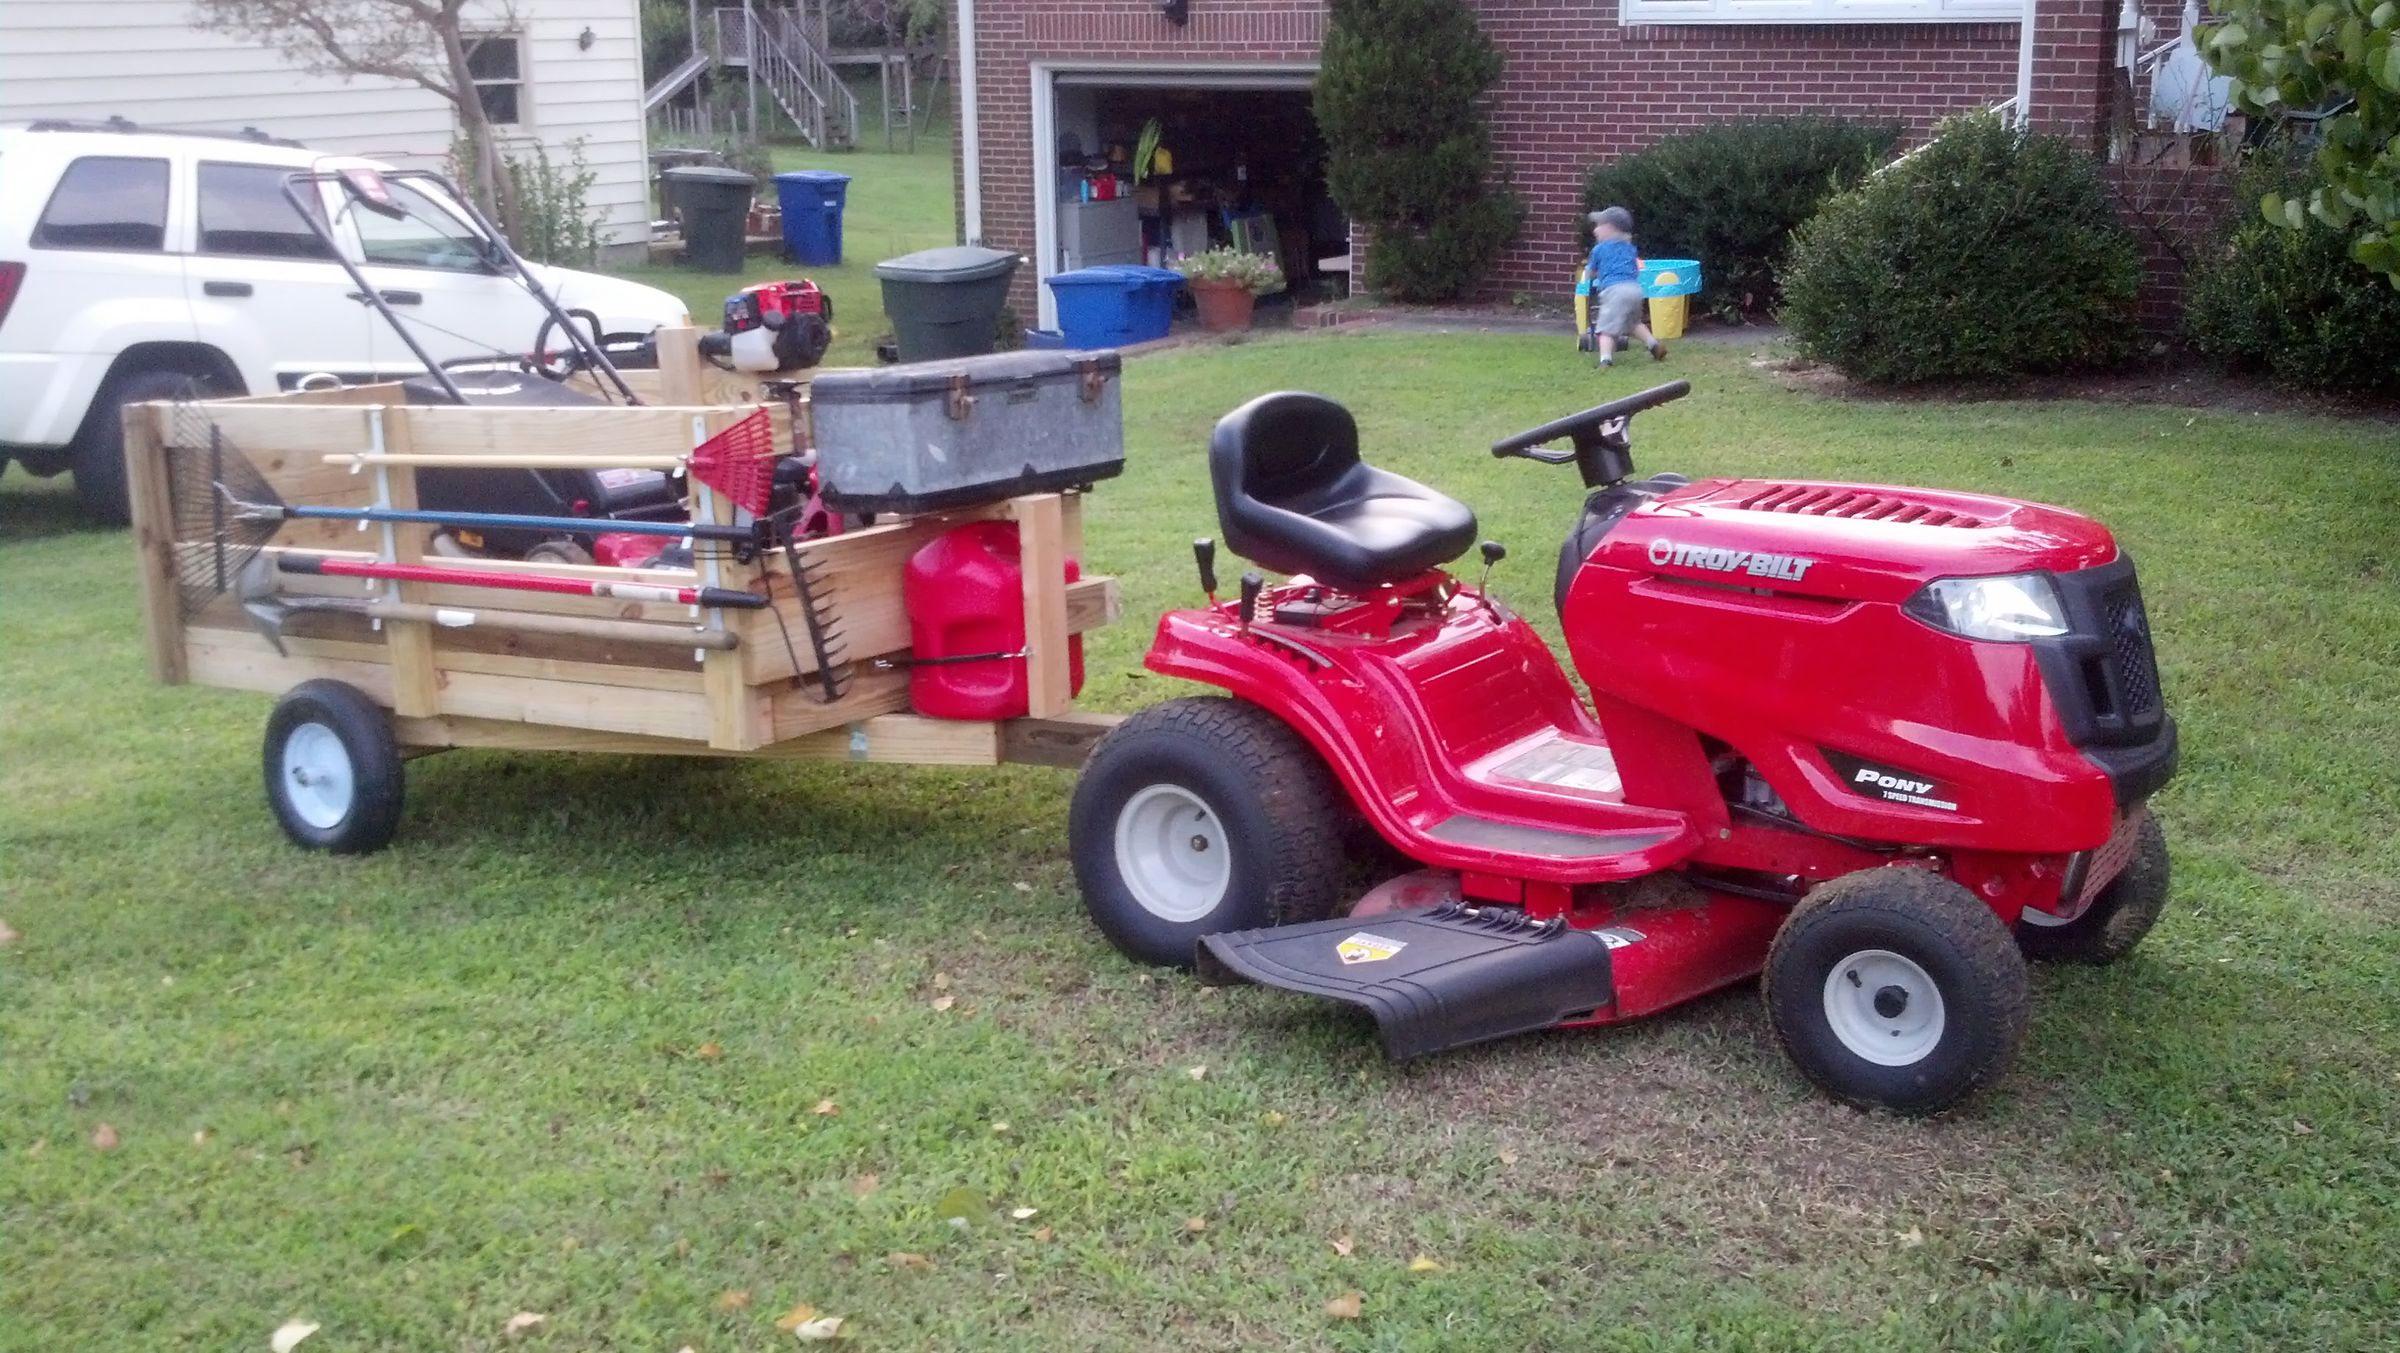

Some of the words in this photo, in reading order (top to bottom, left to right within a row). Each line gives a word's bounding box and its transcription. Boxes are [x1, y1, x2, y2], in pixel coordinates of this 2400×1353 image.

[1673, 543, 1813, 581] TROY-BILT
[1854, 769, 1933, 793] PONY
[1882, 790, 1888, 798] 7
[1887, 791, 1908, 802] SPEED
